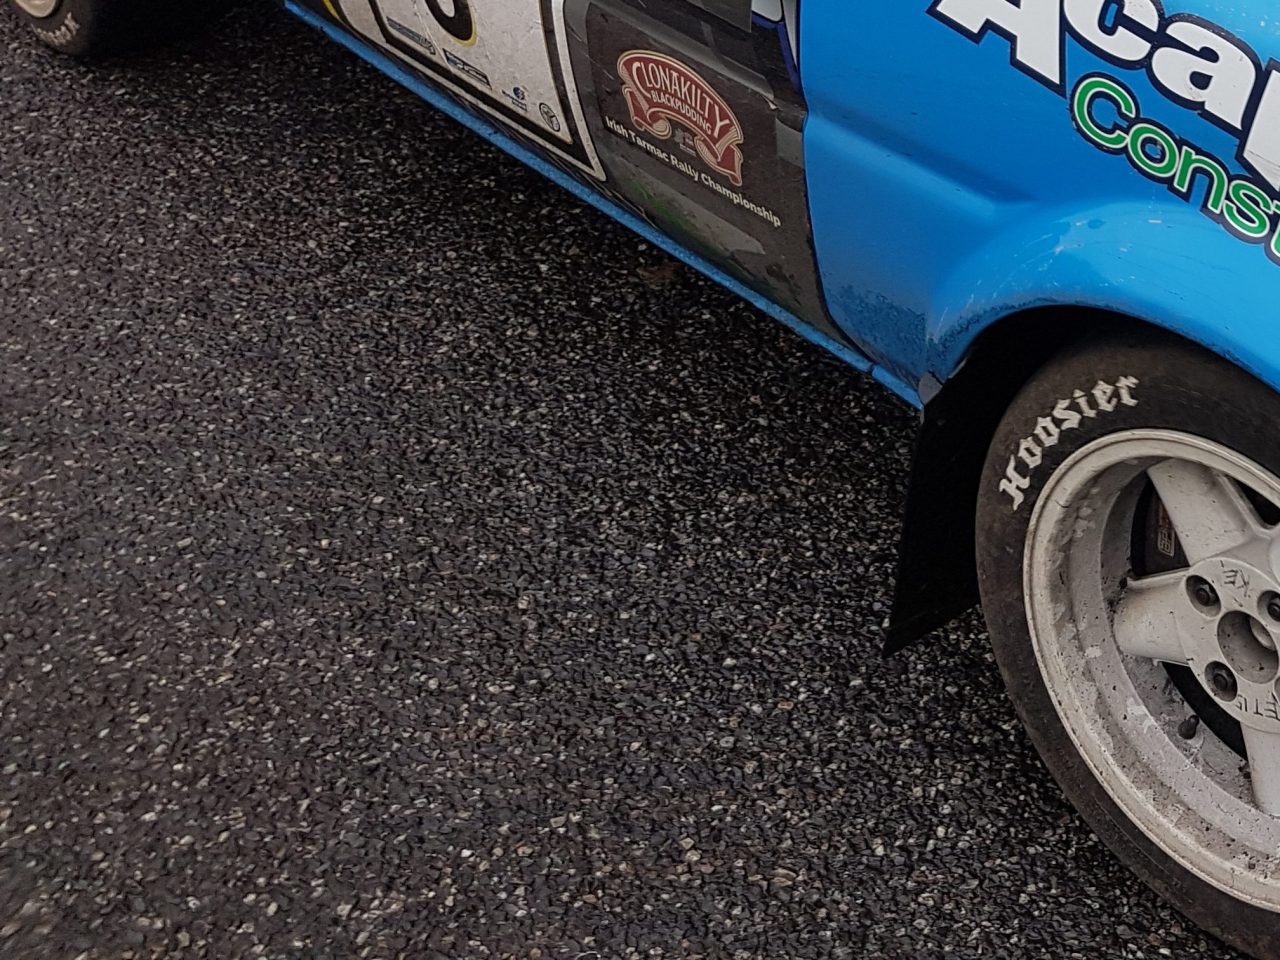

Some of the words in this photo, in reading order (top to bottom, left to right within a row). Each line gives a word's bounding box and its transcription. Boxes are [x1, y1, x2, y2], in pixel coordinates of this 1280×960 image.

[632, 61, 730, 138] CLONAKILTY
[605, 116, 628, 137] Irish
[629, 131, 669, 162] Tarmac
[671, 154, 699, 181] Rally
[701, 173, 781, 227] Championship
[999, 375, 1140, 512] Hoosier
